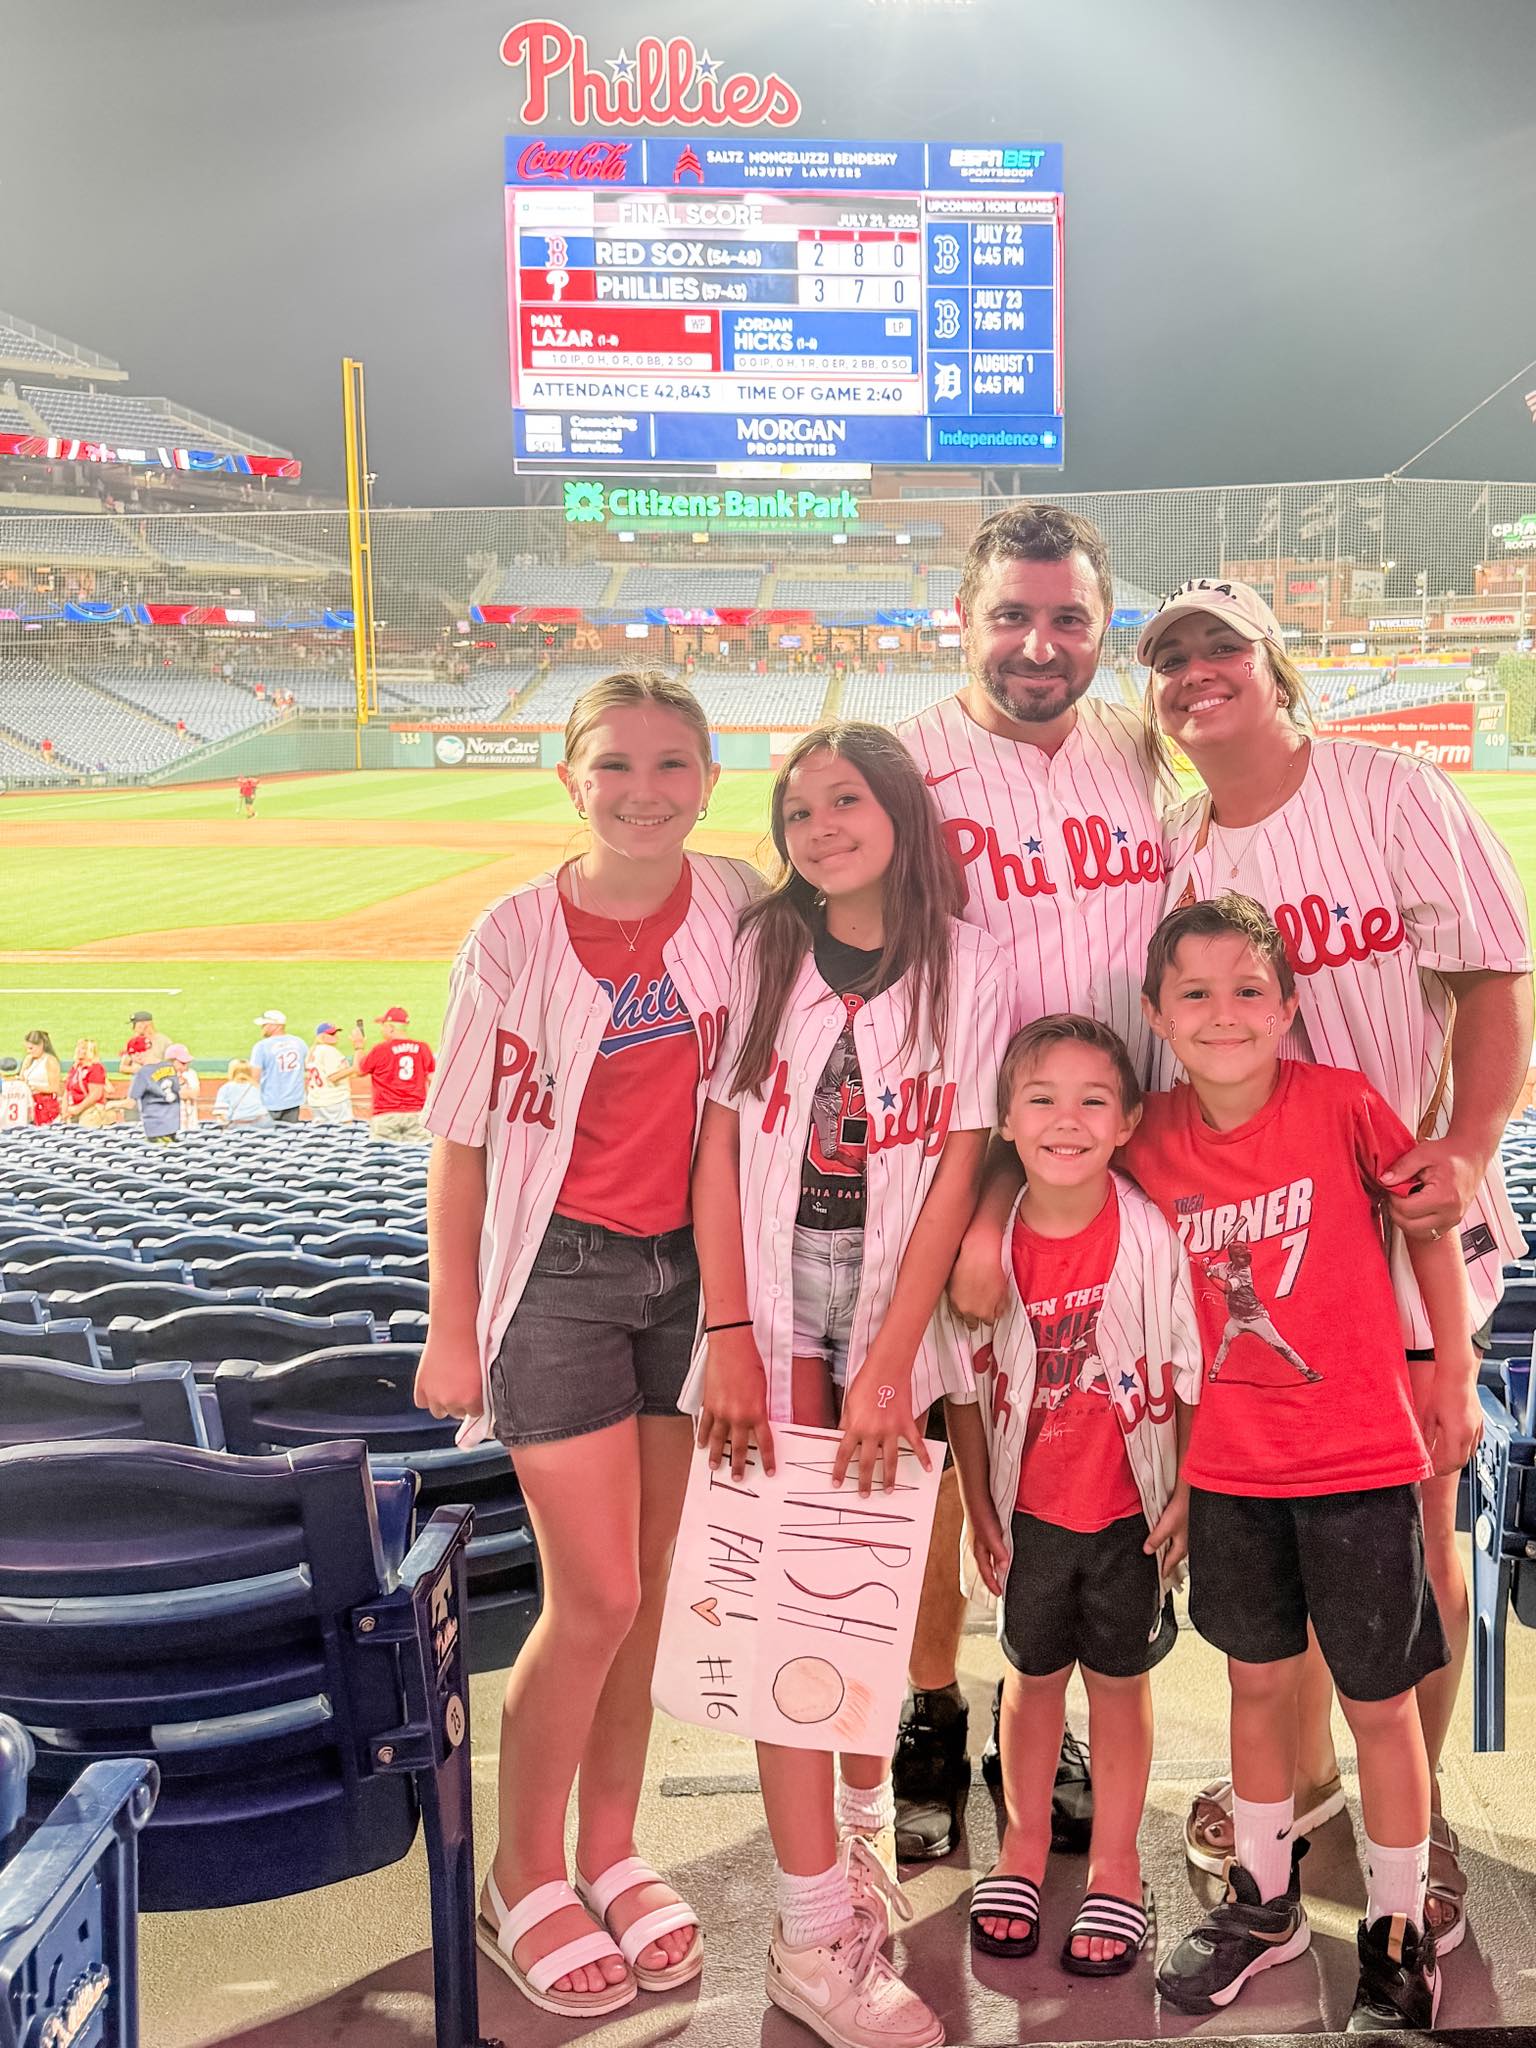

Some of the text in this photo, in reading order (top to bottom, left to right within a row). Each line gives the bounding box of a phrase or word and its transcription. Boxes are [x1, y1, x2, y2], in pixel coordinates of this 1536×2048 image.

[500, 19, 801, 127] Phillies
[516, 140, 632, 181] Coca-Cola
[707, 150, 898, 166] SALTZ MONGELUZZI BENDESKY
[744, 166, 862, 178] INJURY LAWYERS
[960, 168, 1034, 177] SPORTSBOOK
[619, 203, 763, 225] FINAL SCORE
[927, 201, 1054, 213] UPCOMING HOME GAMES
[838, 213, 868, 227] JULY
[973, 224, 1023, 244] JULY 22
[596, 241, 646, 266] RED
[651, 242, 704, 266] SOX
[813, 243, 825, 267] 2
[854, 243, 864, 267] 8
[894, 244, 904, 268] 0
[1003, 246, 1025, 266] PM
[596, 276, 699, 301] PHILLIES
[814, 278, 825, 302] 3
[854, 279, 864, 304] 7
[894, 280, 904, 304] 0
[973, 289, 1023, 309] JULY 23
[530, 314, 562, 328] MAX
[733, 317, 793, 332] JORDAN
[1003, 311, 1025, 331] PM
[532, 329, 594, 347] LAZAR
[733, 331, 794, 351] HICKS
[973, 354, 1034, 374] AUGUST 1
[532, 382, 711, 400] ATTENDANCE 42,843
[737, 386, 903, 401] TIME OF GAME 2:40
[1003, 376, 1025, 395] PM
[736, 418, 846, 441] MORGAN
[939, 430, 1039, 448] Independence
[747, 443, 837, 456] PROPERTIES
[608, 488, 859, 518] Citizens Bank Park
[465, 737, 540, 754] NovaCare
[1485, 733, 1505, 746] 409
[277, 1051, 299, 1073] 12
[399, 1055, 415, 1081] 3
[9, 1103, 18, 1121] 3
[1176, 1177, 1314, 1255] TURNER
[1274, 1228, 1310, 1300] 7
[876, 1385, 896, 1409] P
[777, 1430, 920, 1646] MARSH
[696, 1655, 738, 1720] #16
